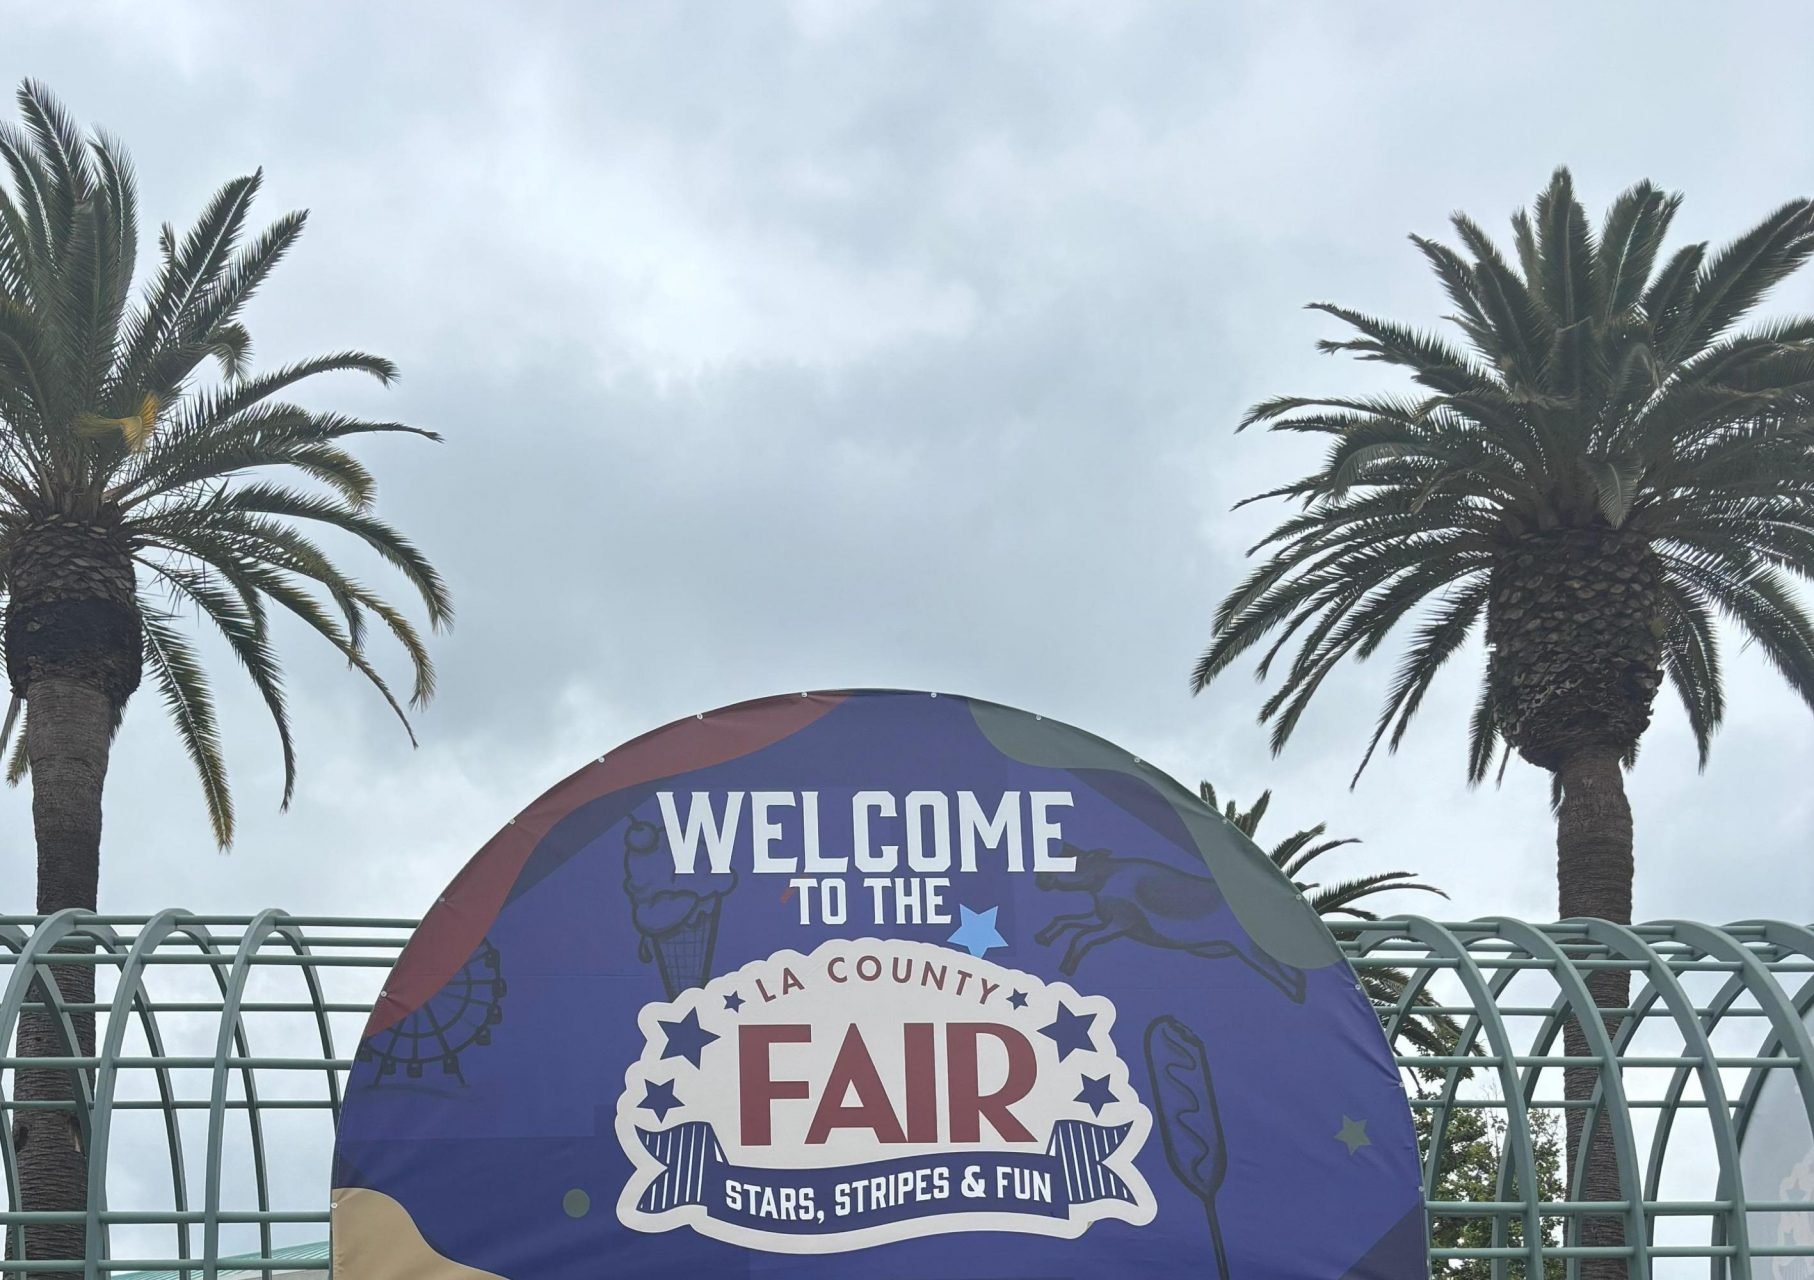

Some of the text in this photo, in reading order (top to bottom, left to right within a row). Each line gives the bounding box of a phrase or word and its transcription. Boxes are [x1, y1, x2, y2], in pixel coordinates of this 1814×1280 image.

[656, 790, 1077, 875] WELCOME
[789, 877, 952, 925] TO THE
[755, 955, 1000, 1005] LA COUNTY
[738, 1022, 1039, 1147] FAIR
[725, 1164, 1052, 1224] STARS, STRIPES & FUN
